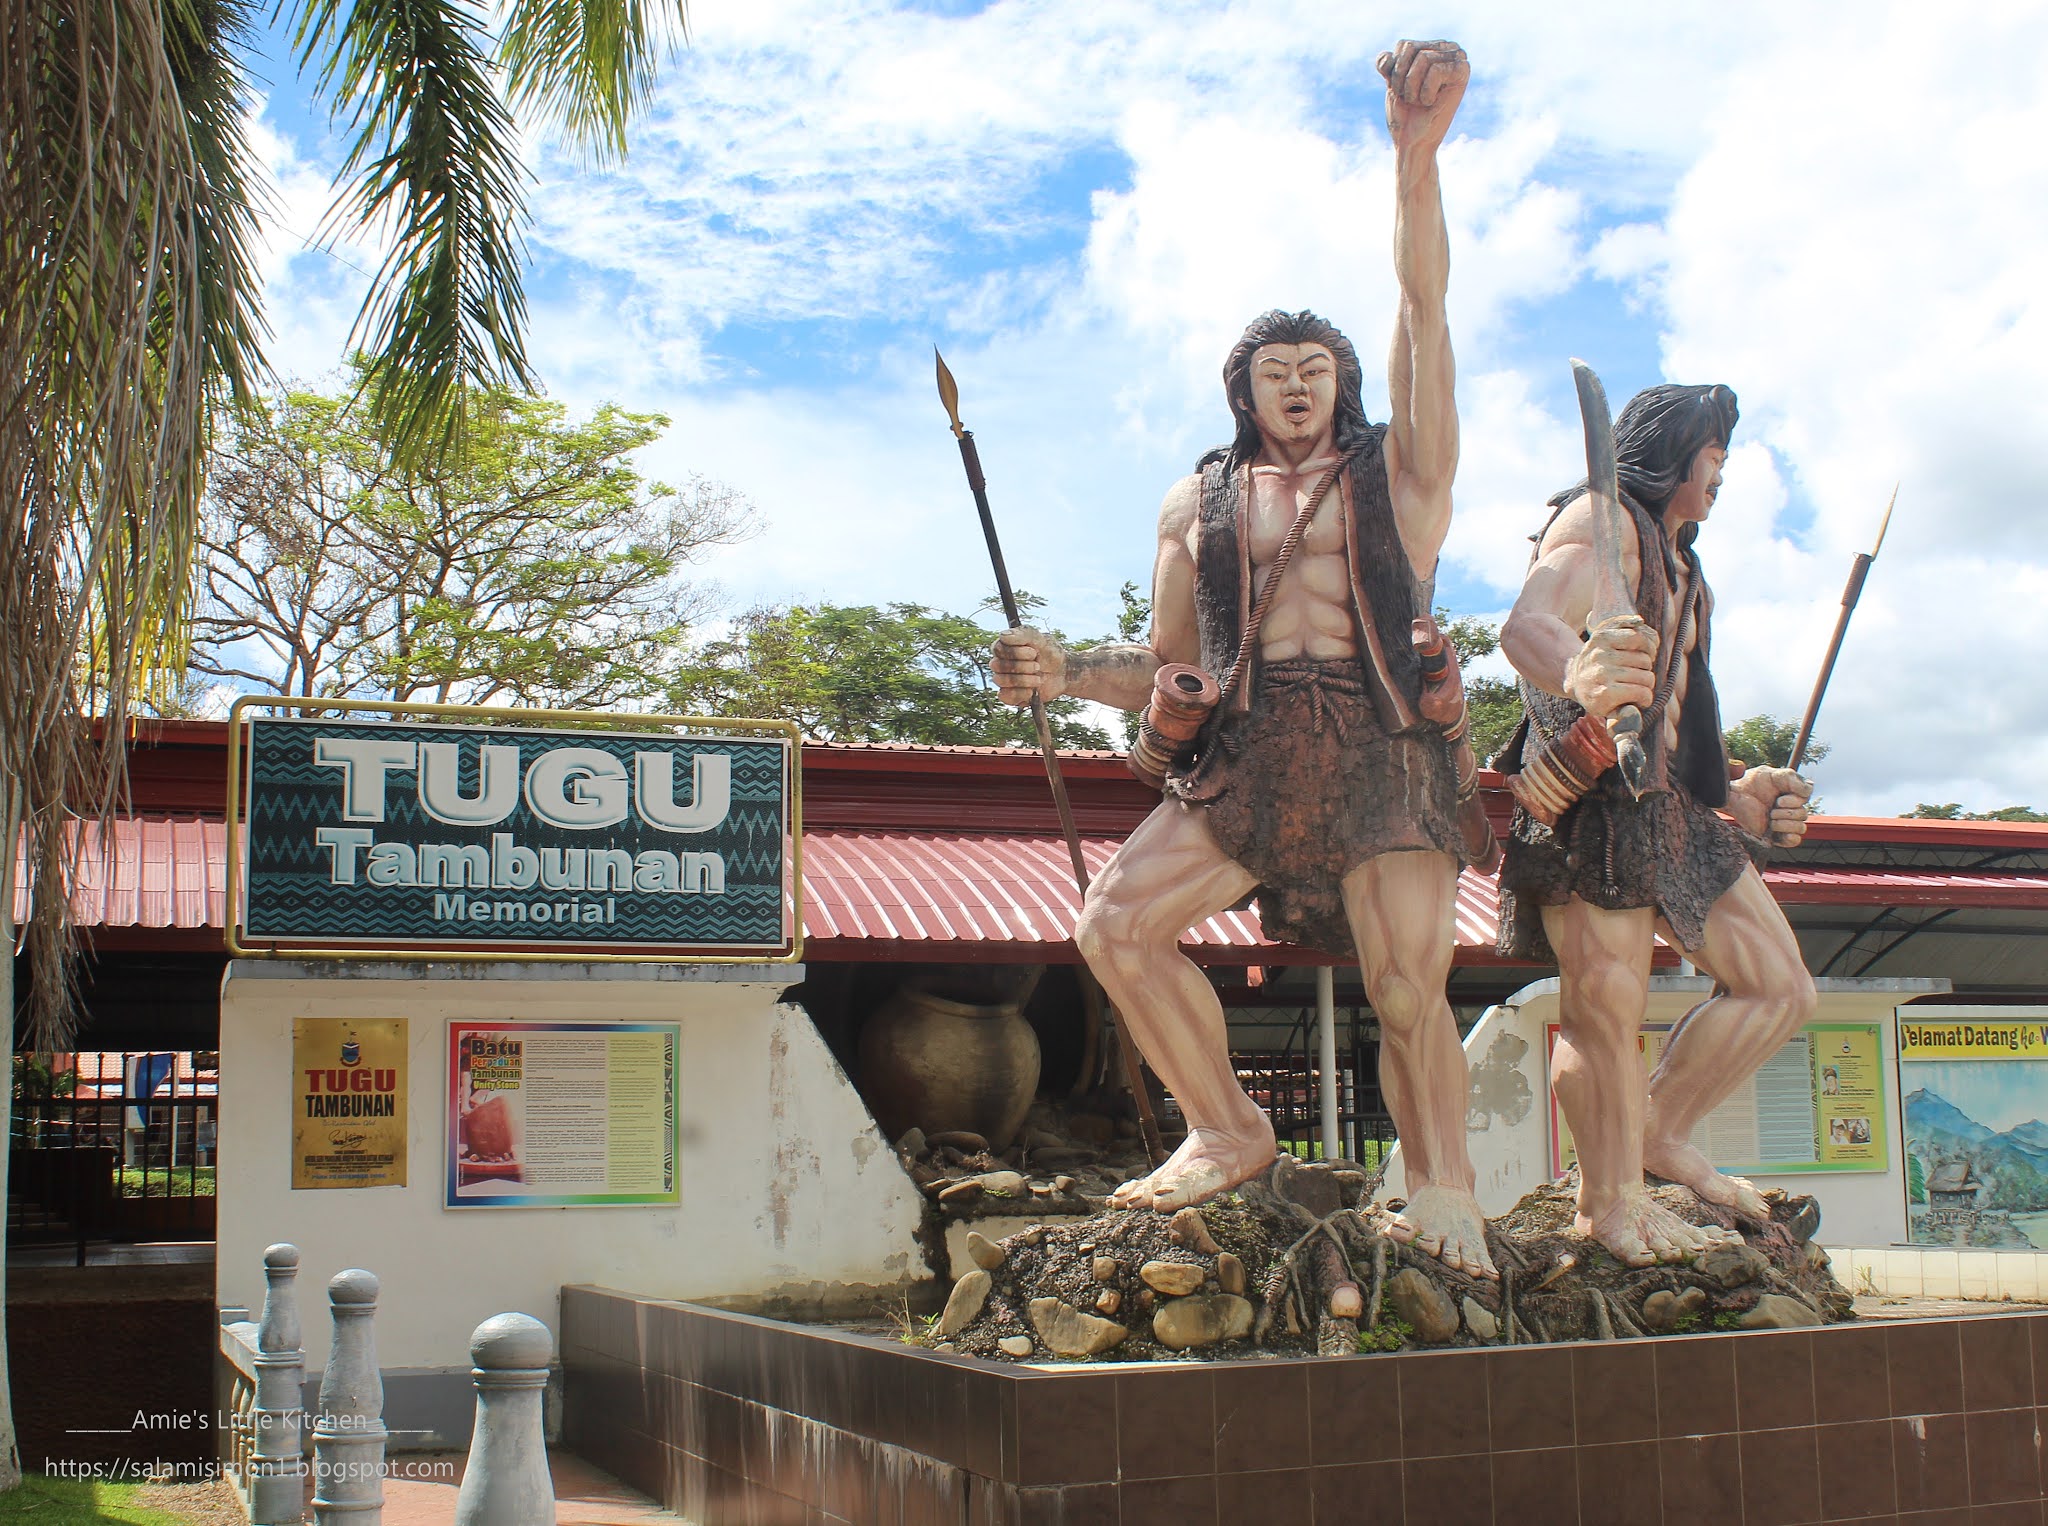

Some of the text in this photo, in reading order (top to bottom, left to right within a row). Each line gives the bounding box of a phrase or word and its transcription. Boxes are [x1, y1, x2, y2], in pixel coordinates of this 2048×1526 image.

[314, 737, 732, 833] TUGU
[315, 826, 726, 894] Tambunan
[433, 894, 616, 924] Memorial
[471, 1037, 521, 1056] Batu
[1964, 1025, 2019, 1050] Datang
[472, 1057, 520, 1067] Perpaduan
[472, 1068, 520, 1078] Tambunan
[304, 1069, 396, 1093] TUGU
[474, 1081, 519, 1091] Unity Stone
[305, 1094, 395, 1118] TAMBUNAN
